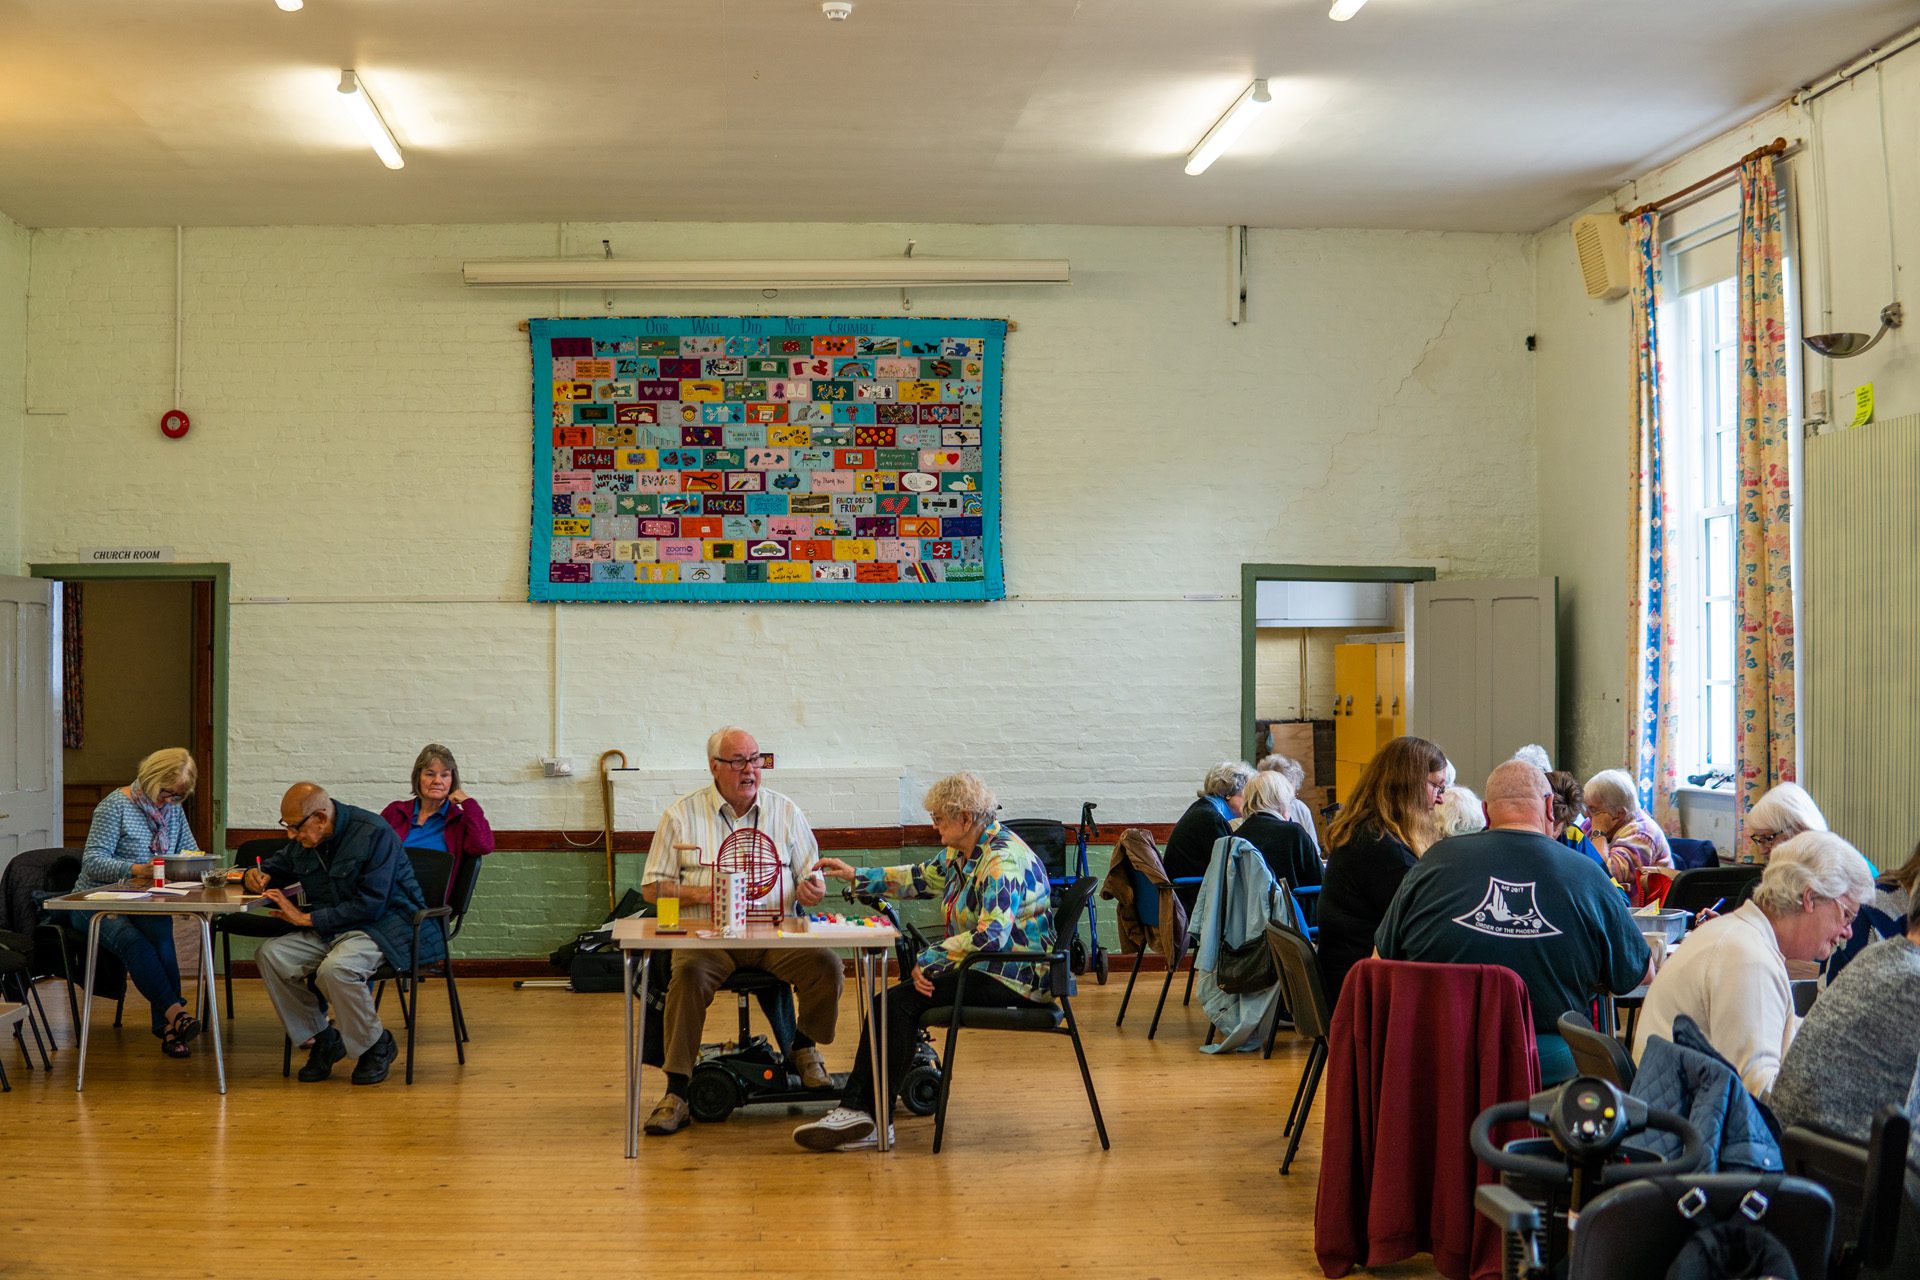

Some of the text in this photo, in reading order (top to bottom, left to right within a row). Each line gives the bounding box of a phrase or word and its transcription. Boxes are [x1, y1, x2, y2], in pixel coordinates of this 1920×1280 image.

[578, 453, 611, 465] NOAH
[597, 473, 625, 482] WHICH
[707, 499, 743, 512] ROCKS
[836, 497, 873, 505] FANCY DRESS
[841, 504, 864, 513] FRIDAY
[93, 550, 161, 560] CHURCH ROOM
[1475, 921, 1495, 931] ORDER
